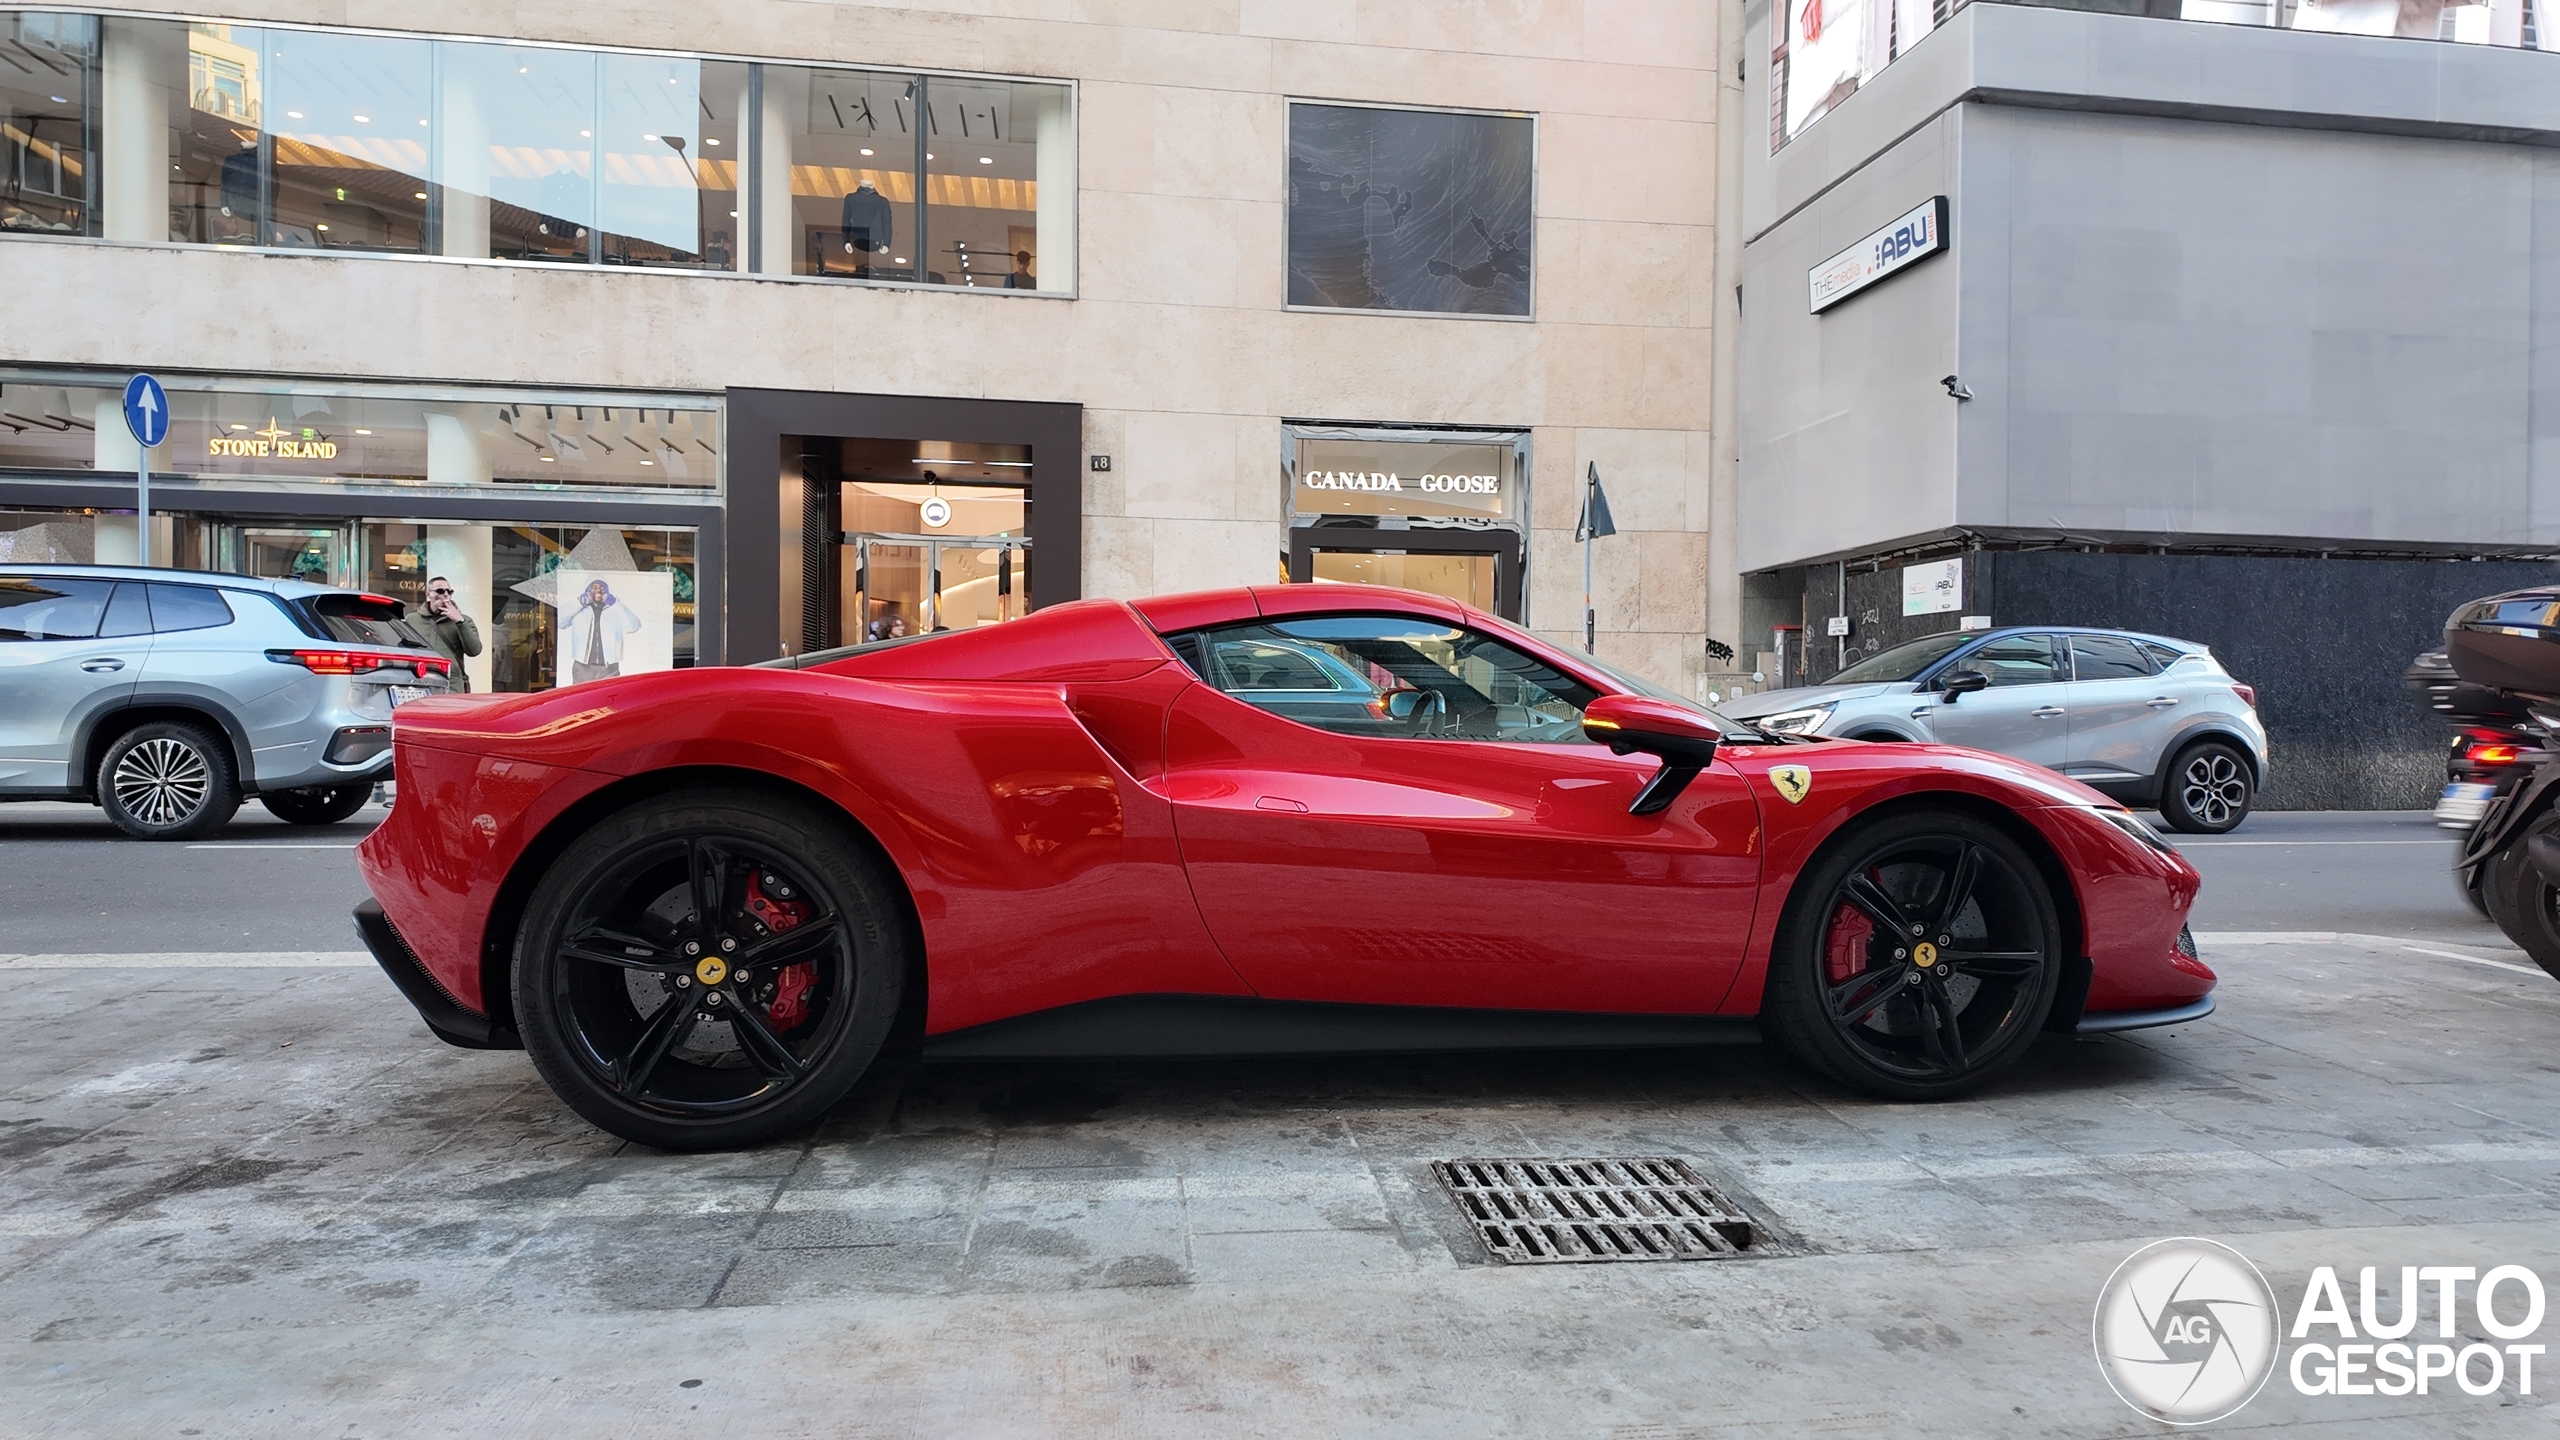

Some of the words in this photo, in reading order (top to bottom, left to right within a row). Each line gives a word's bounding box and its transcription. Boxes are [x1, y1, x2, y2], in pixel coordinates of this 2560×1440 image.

[1881, 215, 1927, 267] ABU
[1927, 211, 1935, 242] MEDIA
[209, 438, 270, 457] STONE
[276, 441, 337, 459] ISLAND
[1094, 456, 1108, 469] 18
[1305, 470, 1403, 492] CANADA
[1420, 474, 1498, 494] GOOSE
